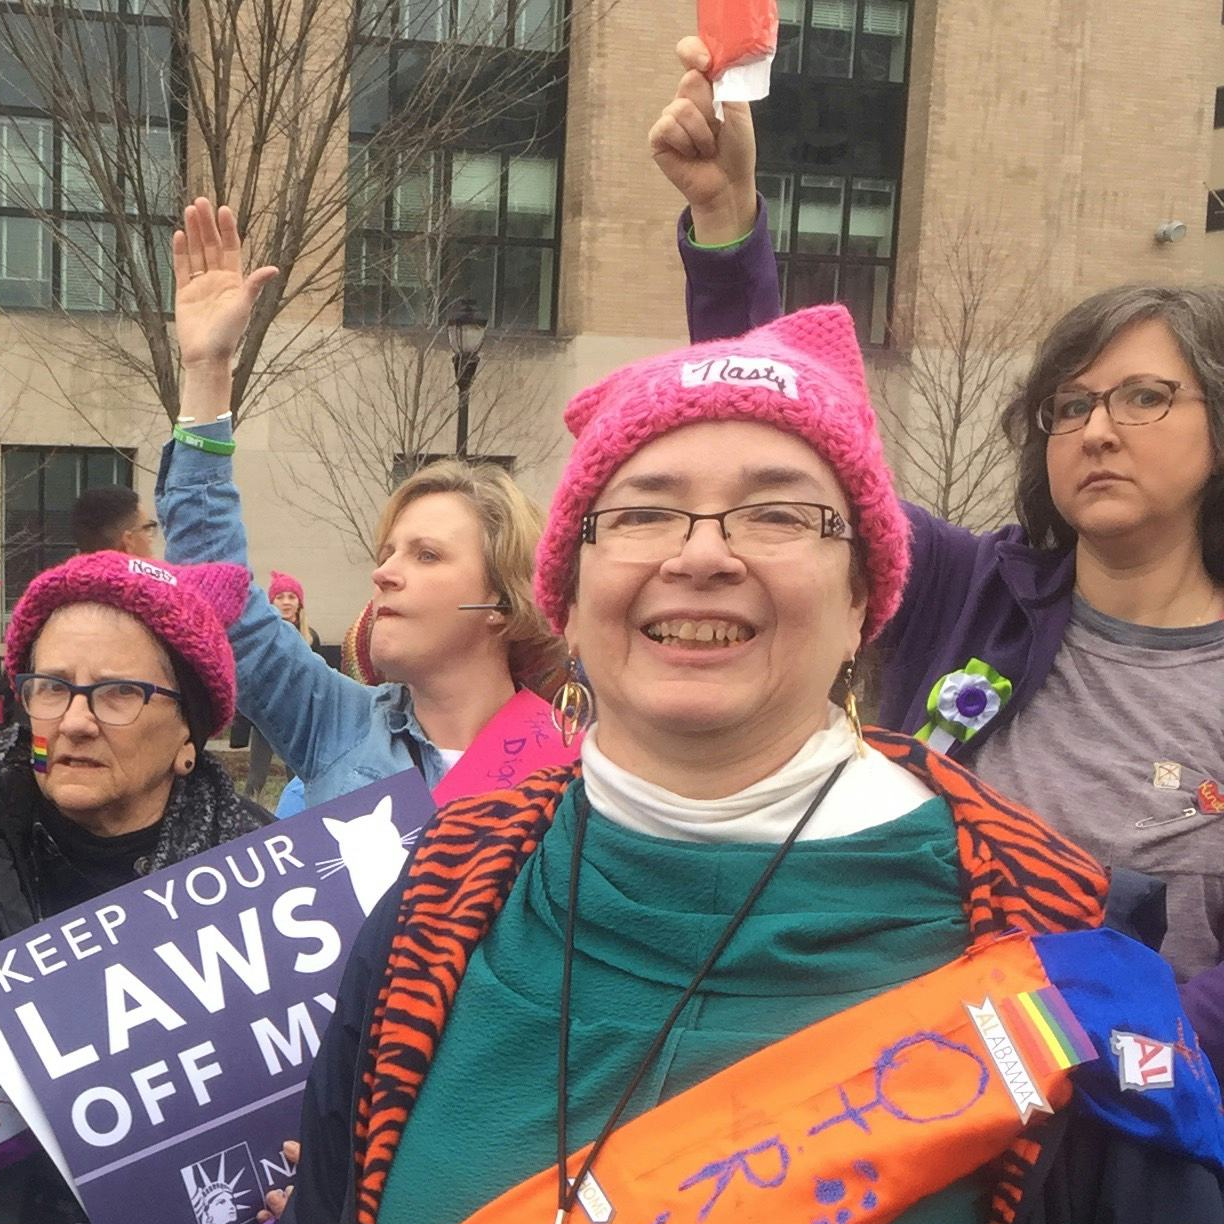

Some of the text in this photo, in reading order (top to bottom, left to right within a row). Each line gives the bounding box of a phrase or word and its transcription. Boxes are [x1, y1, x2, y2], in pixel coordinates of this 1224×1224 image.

[692, 359, 786, 393] Nasty
[143, 834, 306, 921] YOUR
[14, 886, 342, 1081] LAWS
[71, 1041, 224, 1148] OFF
[976, 1011, 1034, 1107] ALABAMA
[1133, 1038, 1169, 1086] AL
[259, 1151, 296, 1186] N
